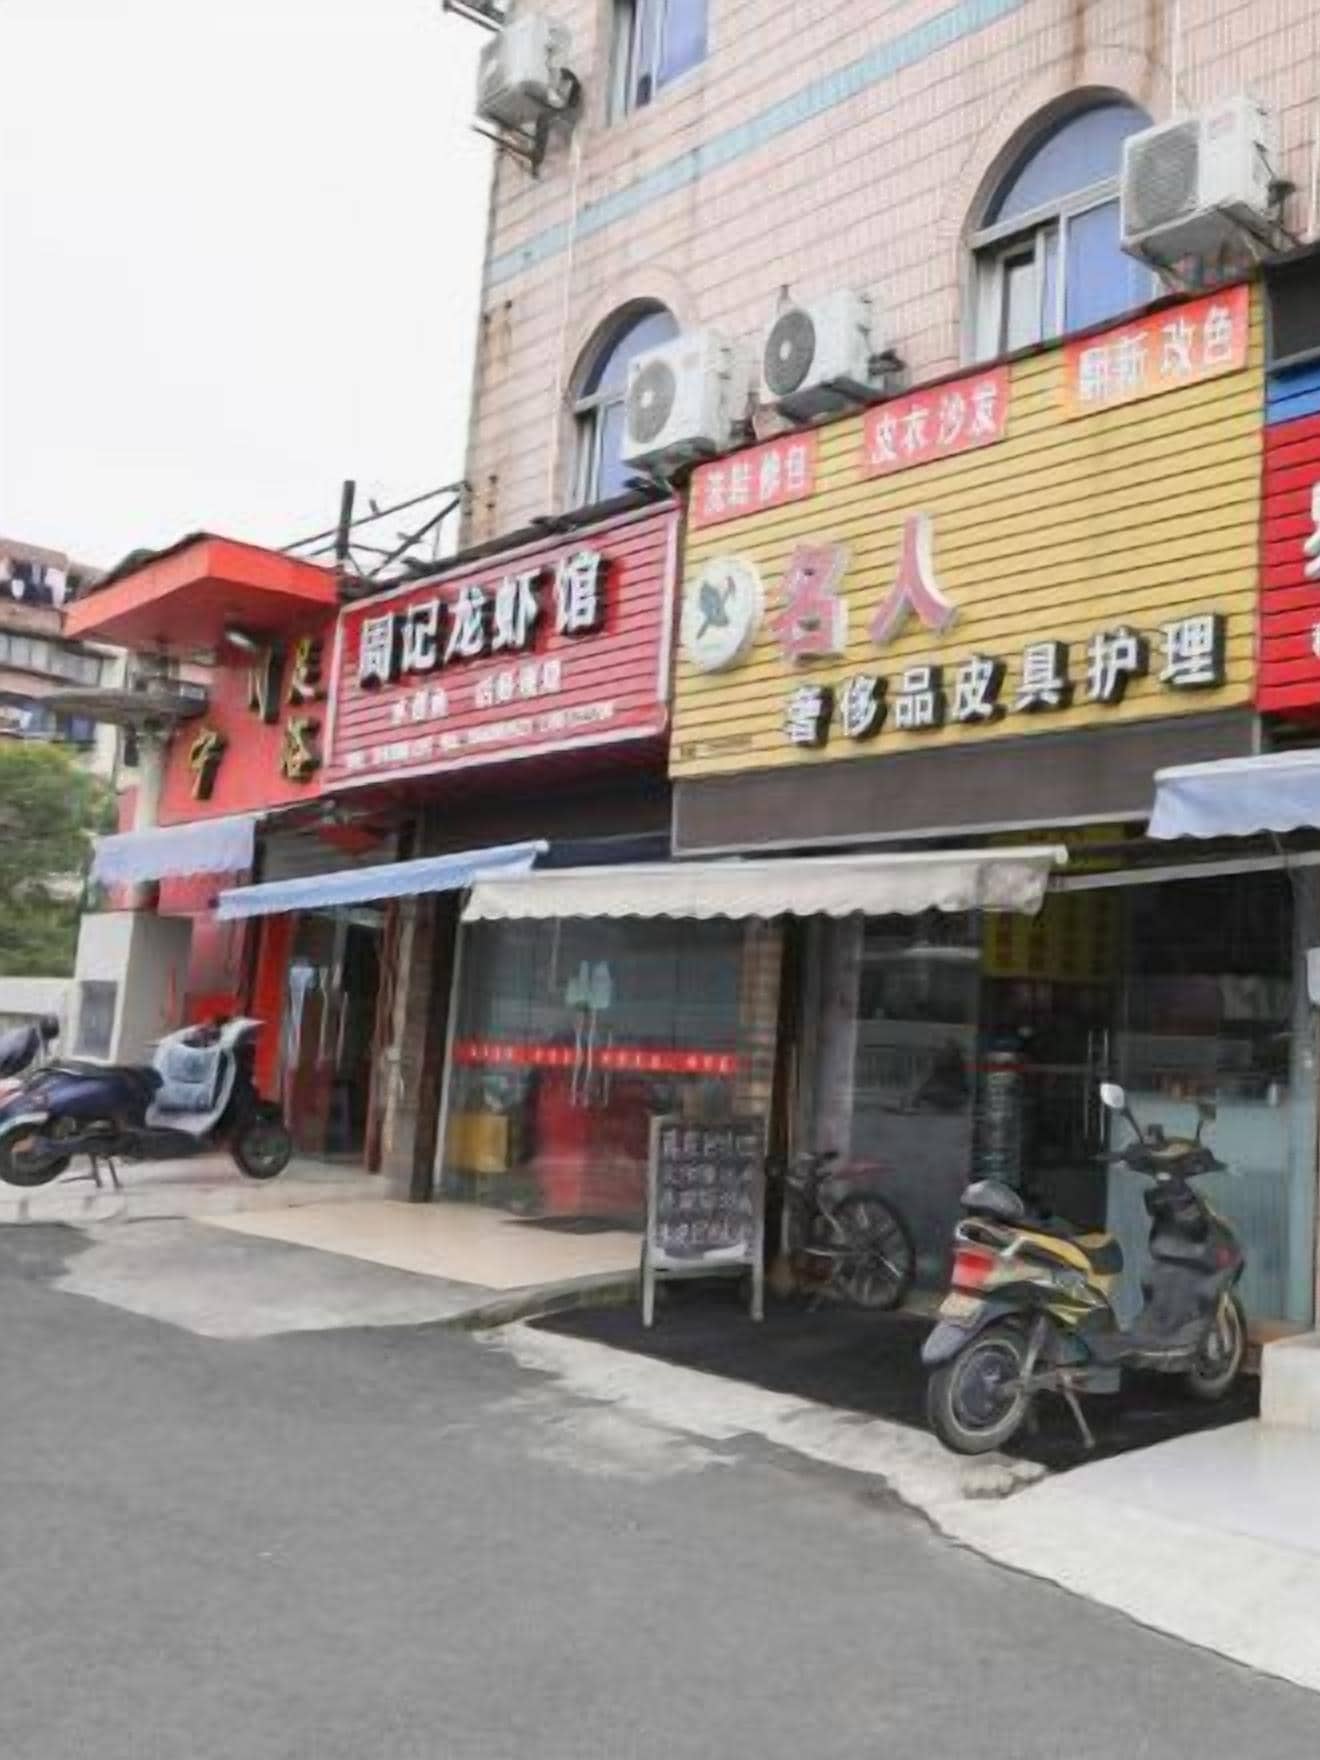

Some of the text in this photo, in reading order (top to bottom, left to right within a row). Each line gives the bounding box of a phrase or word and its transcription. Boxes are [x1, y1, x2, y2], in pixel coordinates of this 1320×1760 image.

[358, 549, 602, 688] 周记龙虾馆
[768, 511, 961, 669] 名人
[784, 613, 1222, 748] 奢侈品皮具护理
